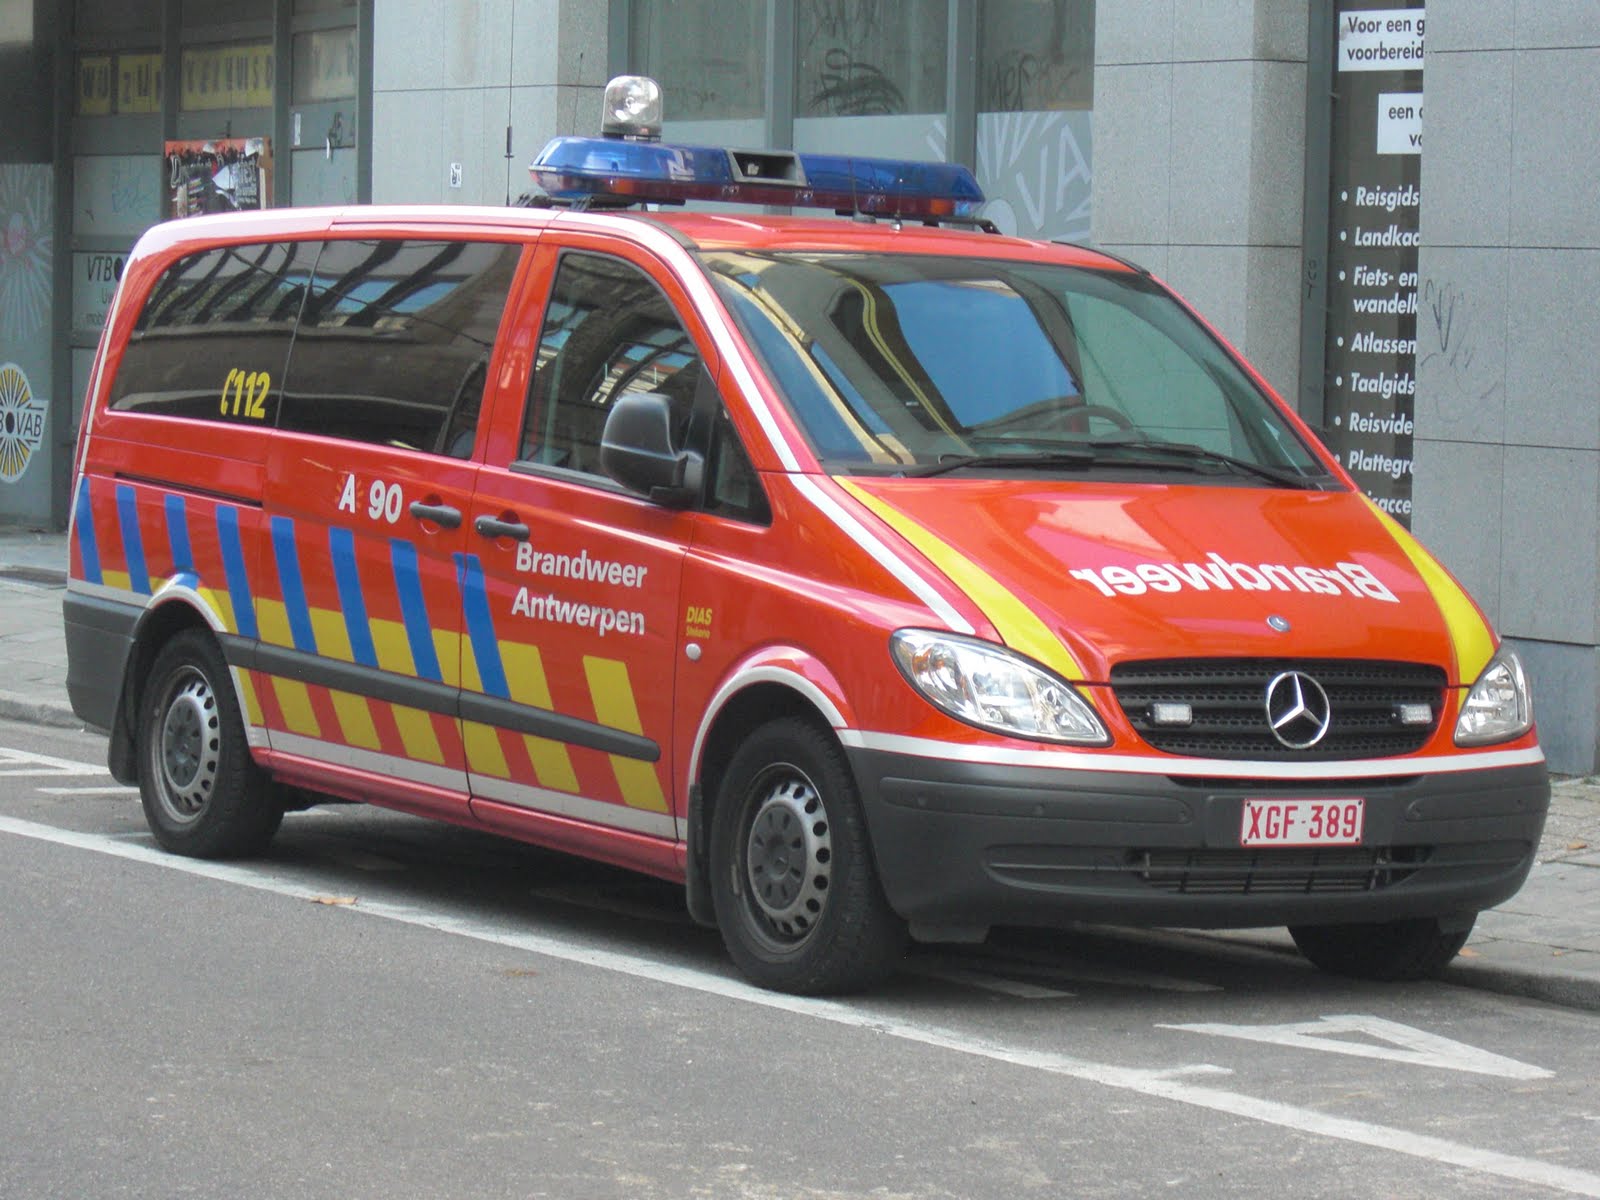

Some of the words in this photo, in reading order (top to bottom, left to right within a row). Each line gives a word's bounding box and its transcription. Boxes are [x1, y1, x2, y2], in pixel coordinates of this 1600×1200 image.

[1348, 16, 1382, 33] Voor
[1386, 19, 1411, 32] een
[1347, 41, 1424, 61] voorbereid
[1389, 106, 1413, 119] een
[1356, 184, 1419, 212] Reisgids
[1353, 265, 1394, 287] Fiets-
[1399, 272, 1418, 287] en
[1351, 331, 1416, 354] Atlassen
[233, 370, 270, 418] 112
[1351, 372, 1415, 399] Taalgids
[1349, 412, 1413, 435] Reisvide
[338, 473, 356, 513] A
[368, 479, 403, 524] 90
[516, 541, 647, 588] Brandweer
[511, 587, 645, 637] Antwerpen
[687, 606, 713, 625] DIAS
